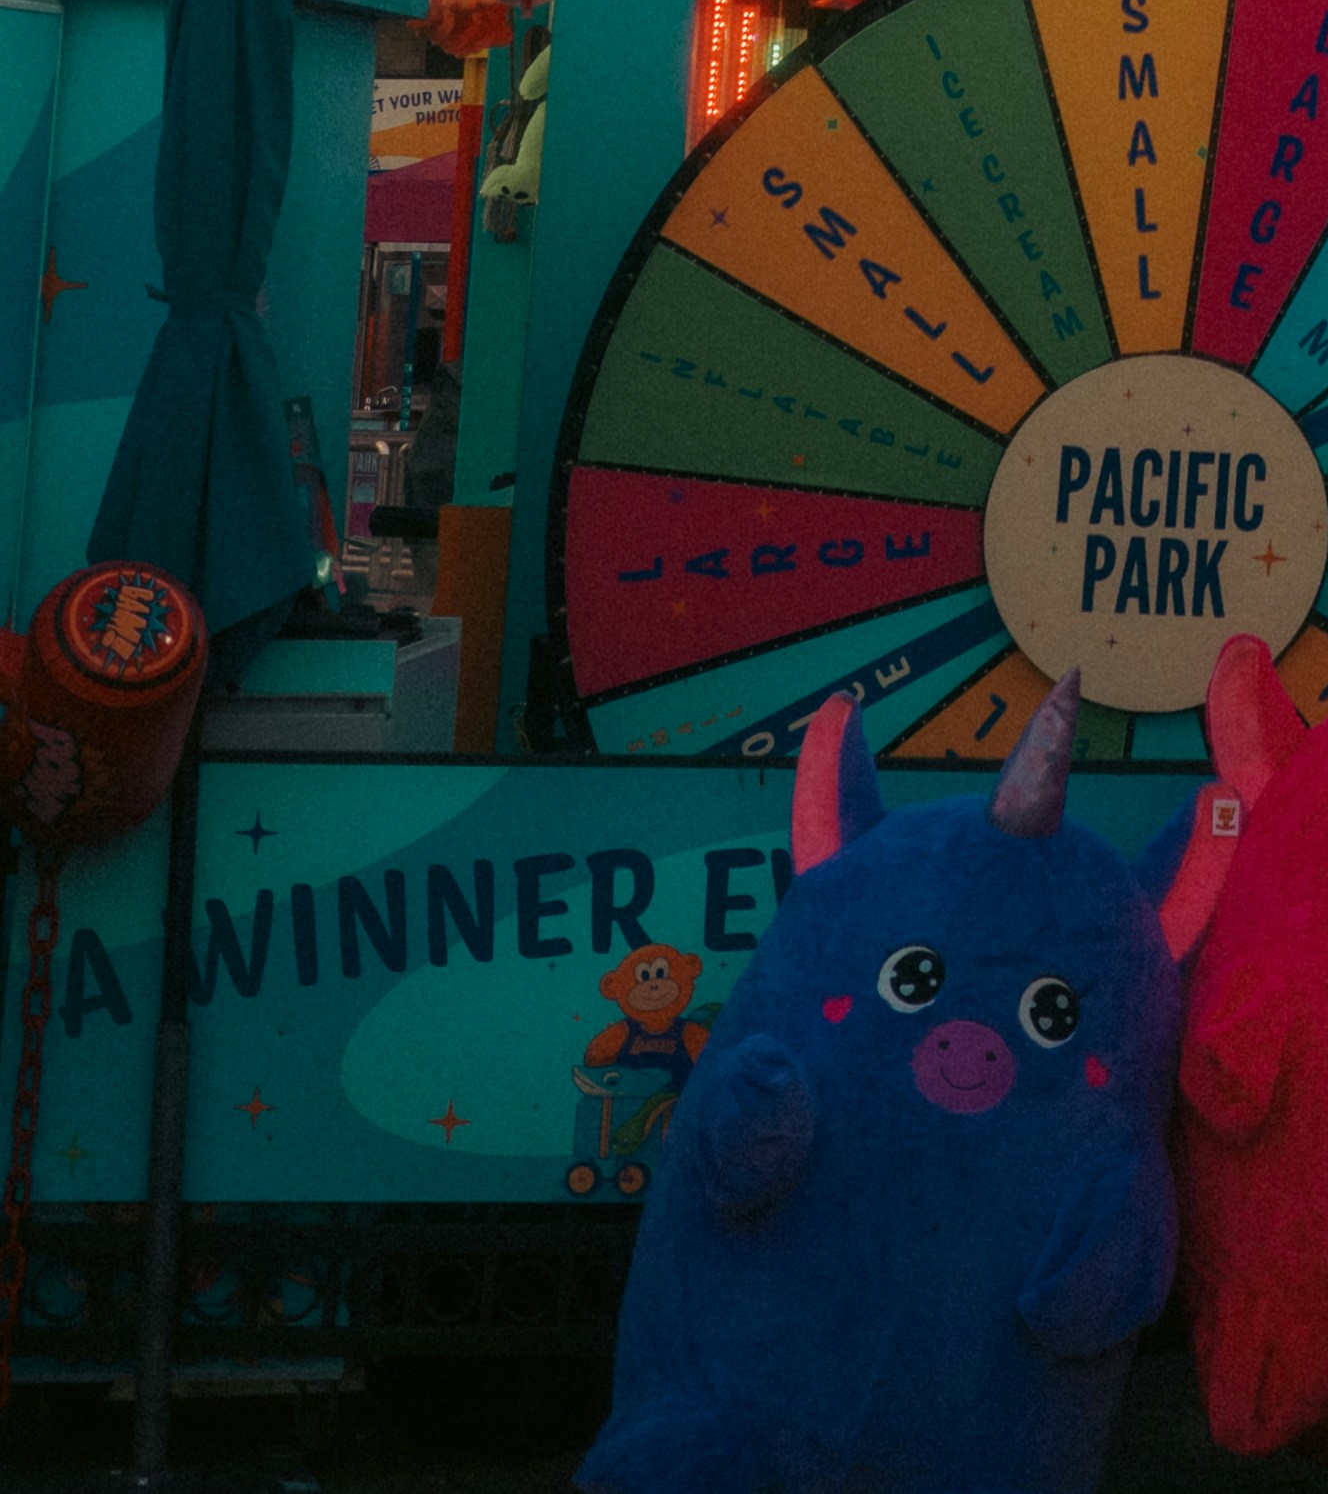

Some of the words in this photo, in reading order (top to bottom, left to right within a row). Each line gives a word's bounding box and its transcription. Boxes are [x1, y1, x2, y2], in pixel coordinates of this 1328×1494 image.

[389, 91, 433, 110] YOUR
[762, 164, 995, 385] SMALL
[639, 351, 963, 470] INFLATABLE
[1055, 444, 1266, 533] PACIFIC
[618, 531, 932, 583] LARGE
[1080, 534, 1228, 620] PARK
[101, 584, 155, 661] BAM!
[625, 704, 745, 754] SMALL
[60, 928, 132, 1039] A
[184, 847, 657, 1009] WINNER
